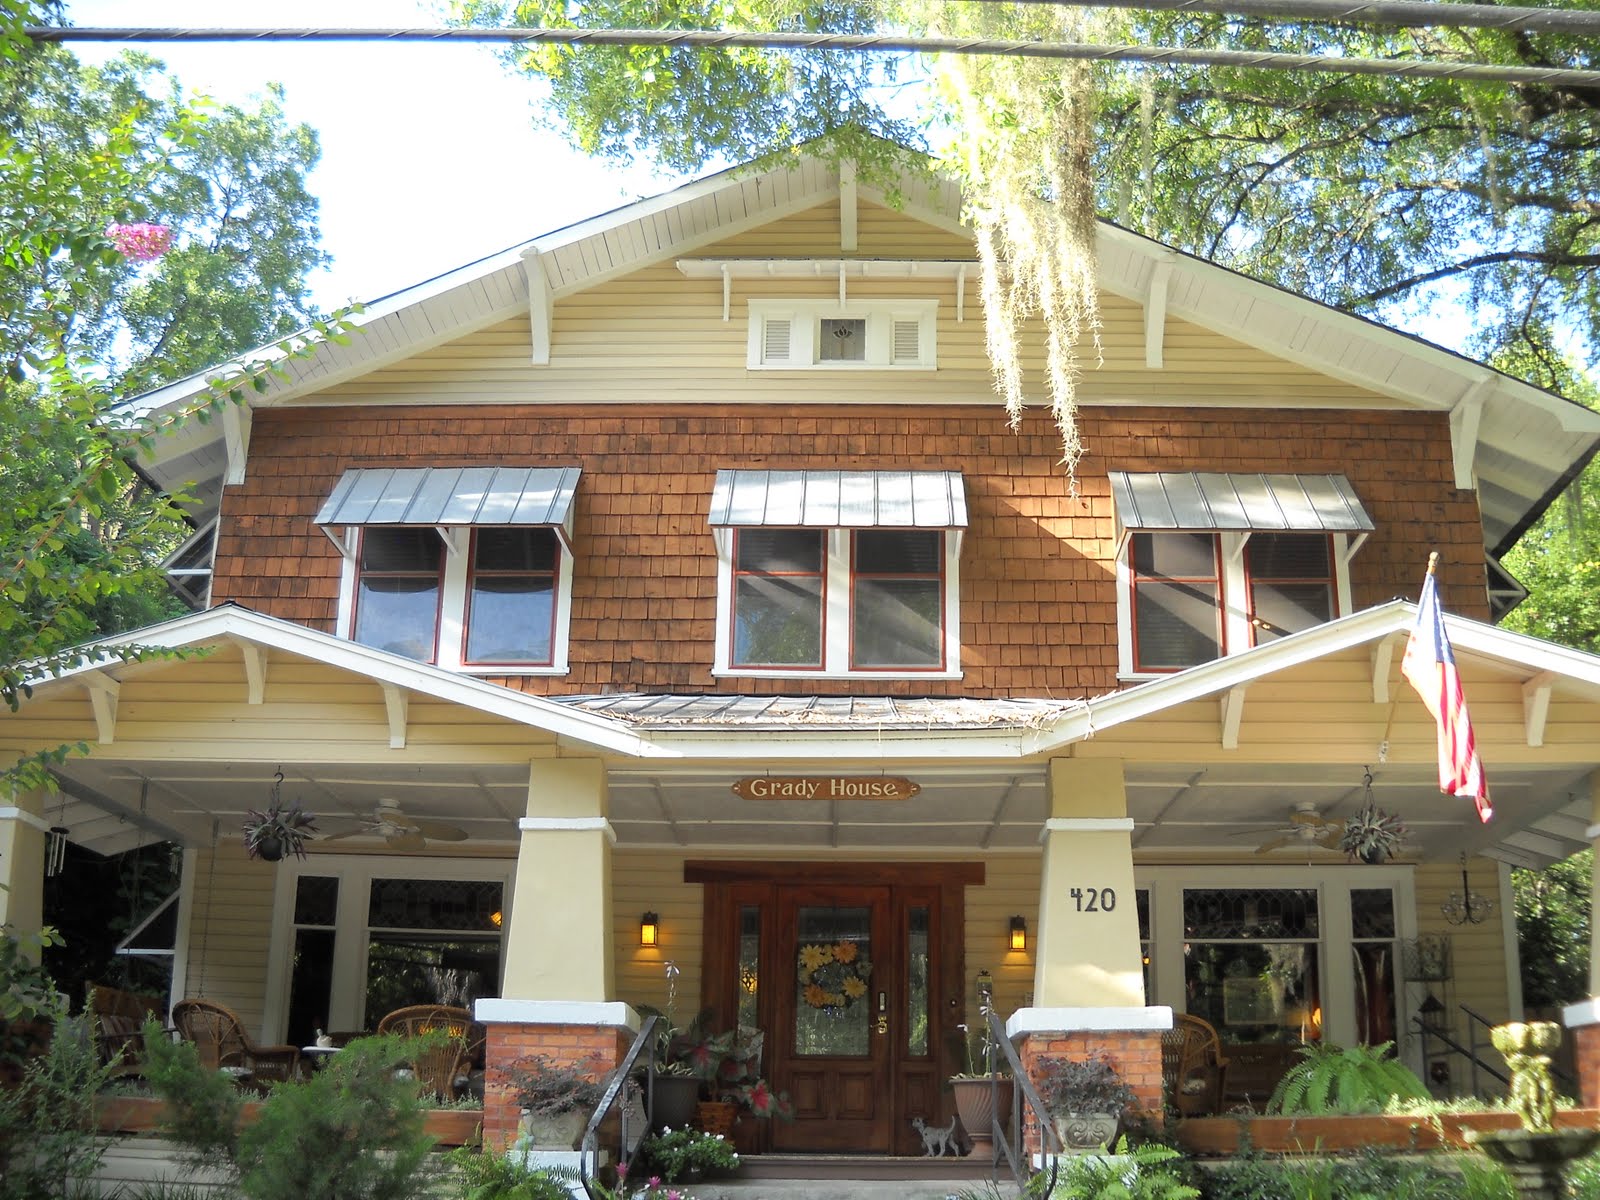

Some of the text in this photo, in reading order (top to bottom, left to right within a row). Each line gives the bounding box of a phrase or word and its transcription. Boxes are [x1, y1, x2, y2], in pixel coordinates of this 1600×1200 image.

[750, 779, 899, 799] Grady House
[1070, 887, 1116, 912] 420
